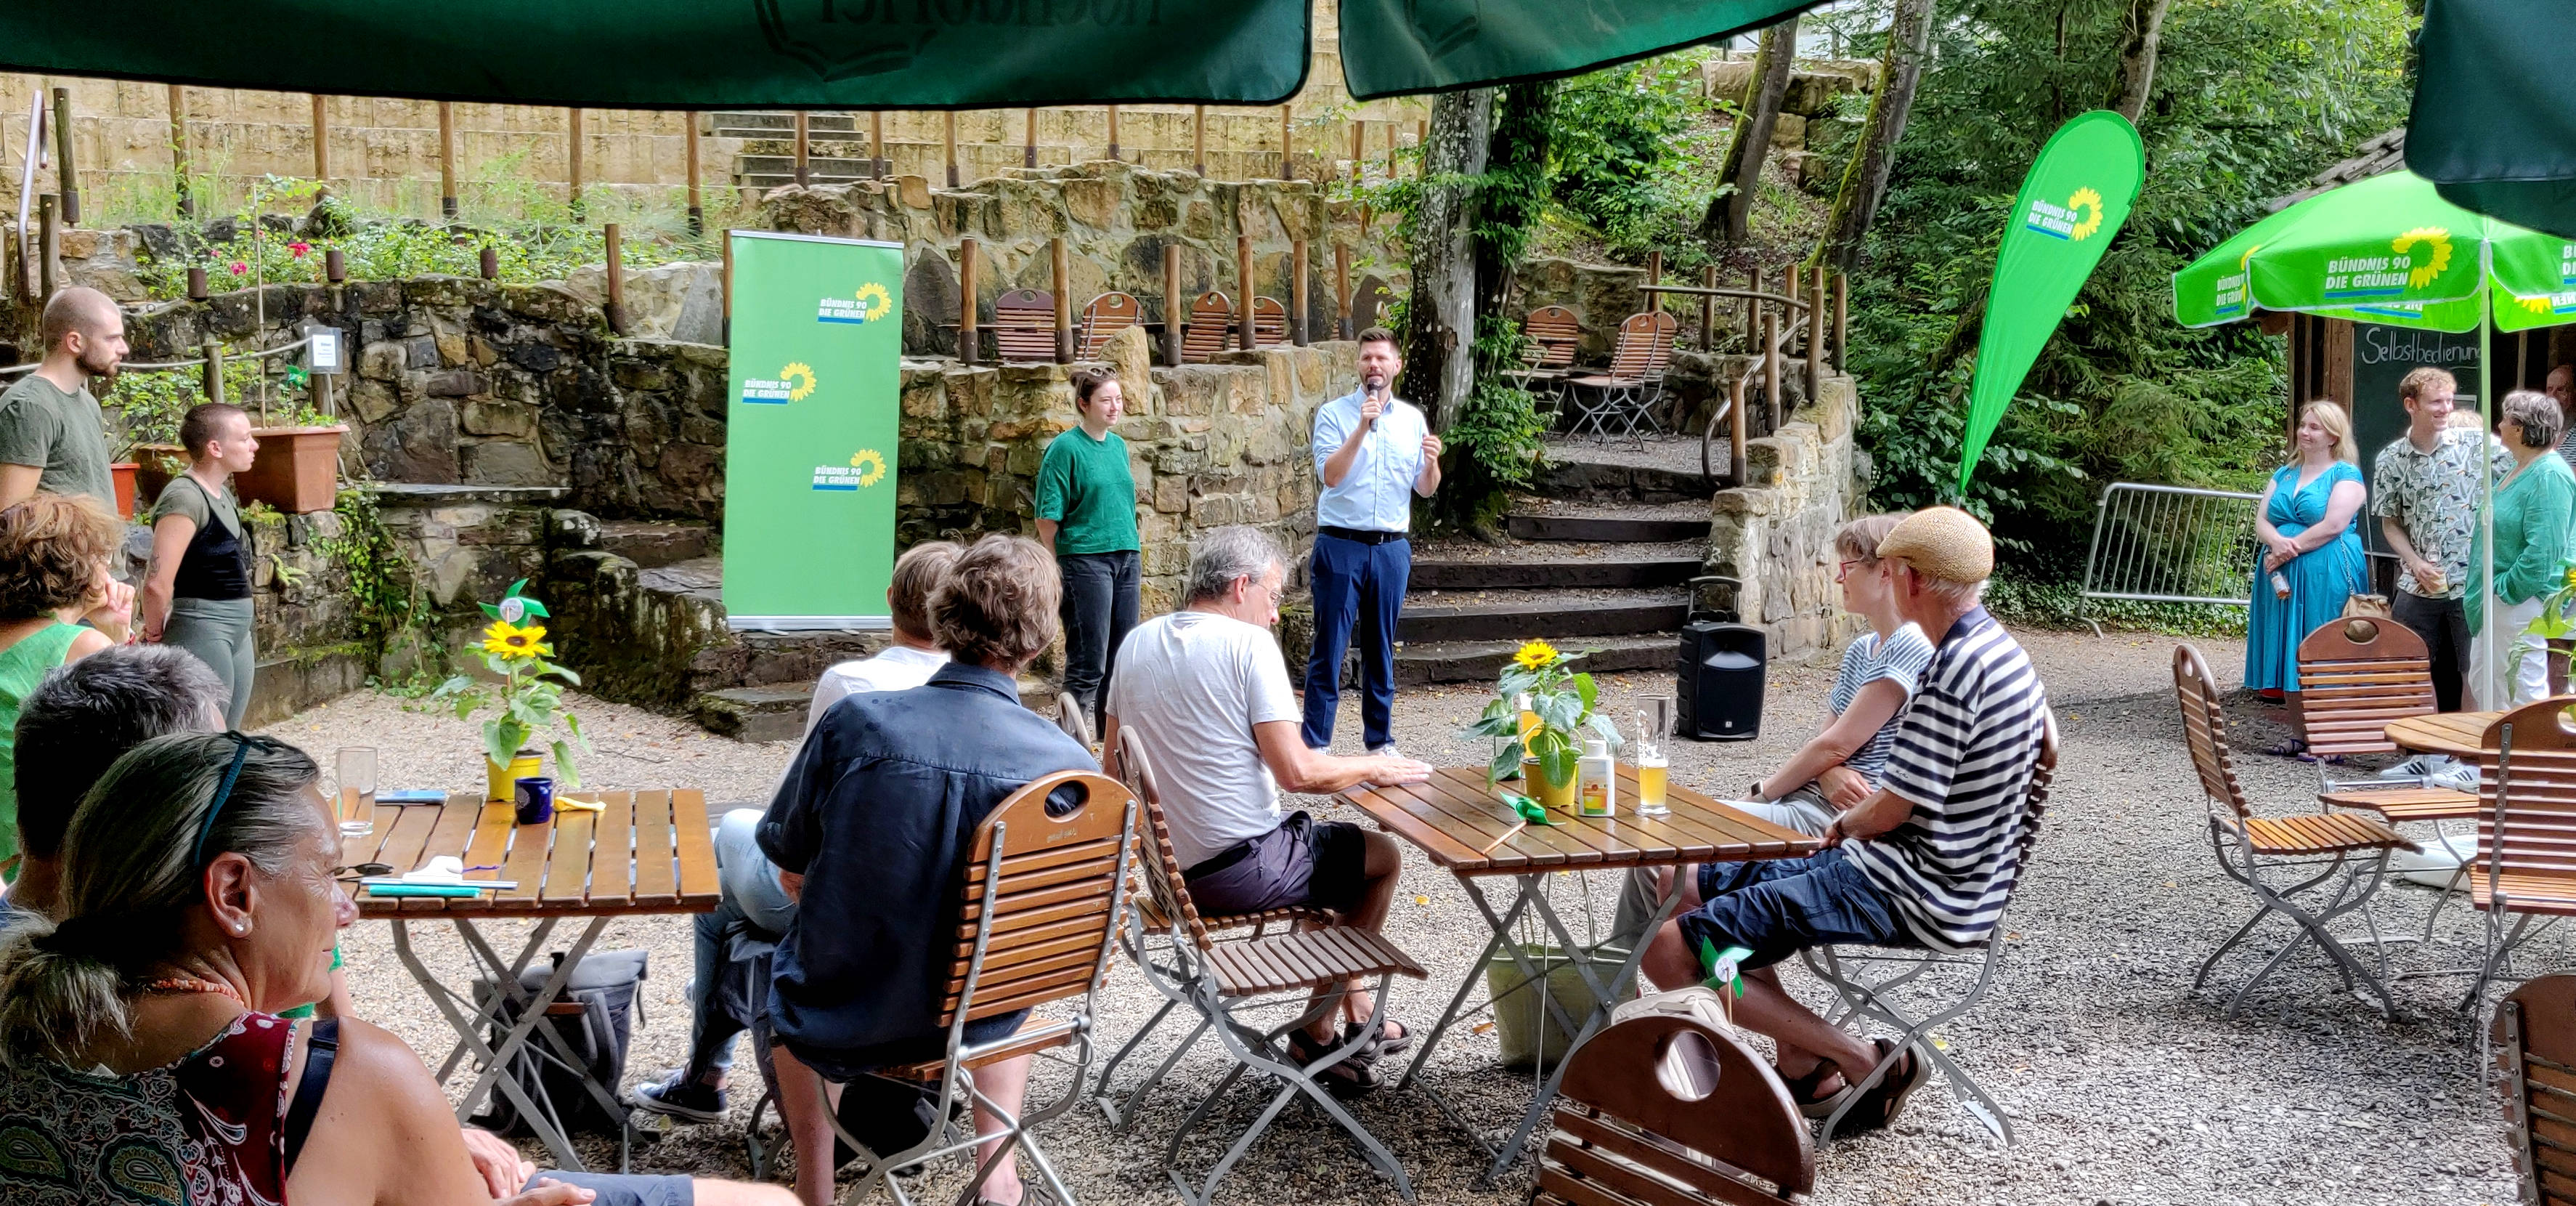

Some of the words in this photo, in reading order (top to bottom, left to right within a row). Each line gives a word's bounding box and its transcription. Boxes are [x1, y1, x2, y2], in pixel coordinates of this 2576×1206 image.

[2032, 199, 2065, 219] BÜNDNIS
[2065, 211, 2077, 222] 90
[2028, 211, 2041, 224] DIE
[2042, 216, 2073, 234] GRÜNEN
[2328, 256, 2389, 273] BÜNDNIS
[2392, 256, 2411, 270] 90
[2562, 262, 2576, 275] DI
[2325, 275, 2348, 289] DIE
[2352, 270, 2408, 287] GRÜNEN
[820, 297, 855, 309] BÜNDNIS
[856, 301, 867, 309] 90
[2216, 293, 2227, 307] DIE
[834, 308, 866, 318] GRÜNEN
[744, 378, 779, 389] BÜNDNIS
[742, 389, 756, 397] DIE
[757, 388, 790, 399] GRÜNEN
[815, 465, 850, 475] BÜNDNIS
[850, 467, 862, 476] 90
[813, 475, 826, 484] DIE
[828, 474, 861, 485] GRÜNEN
